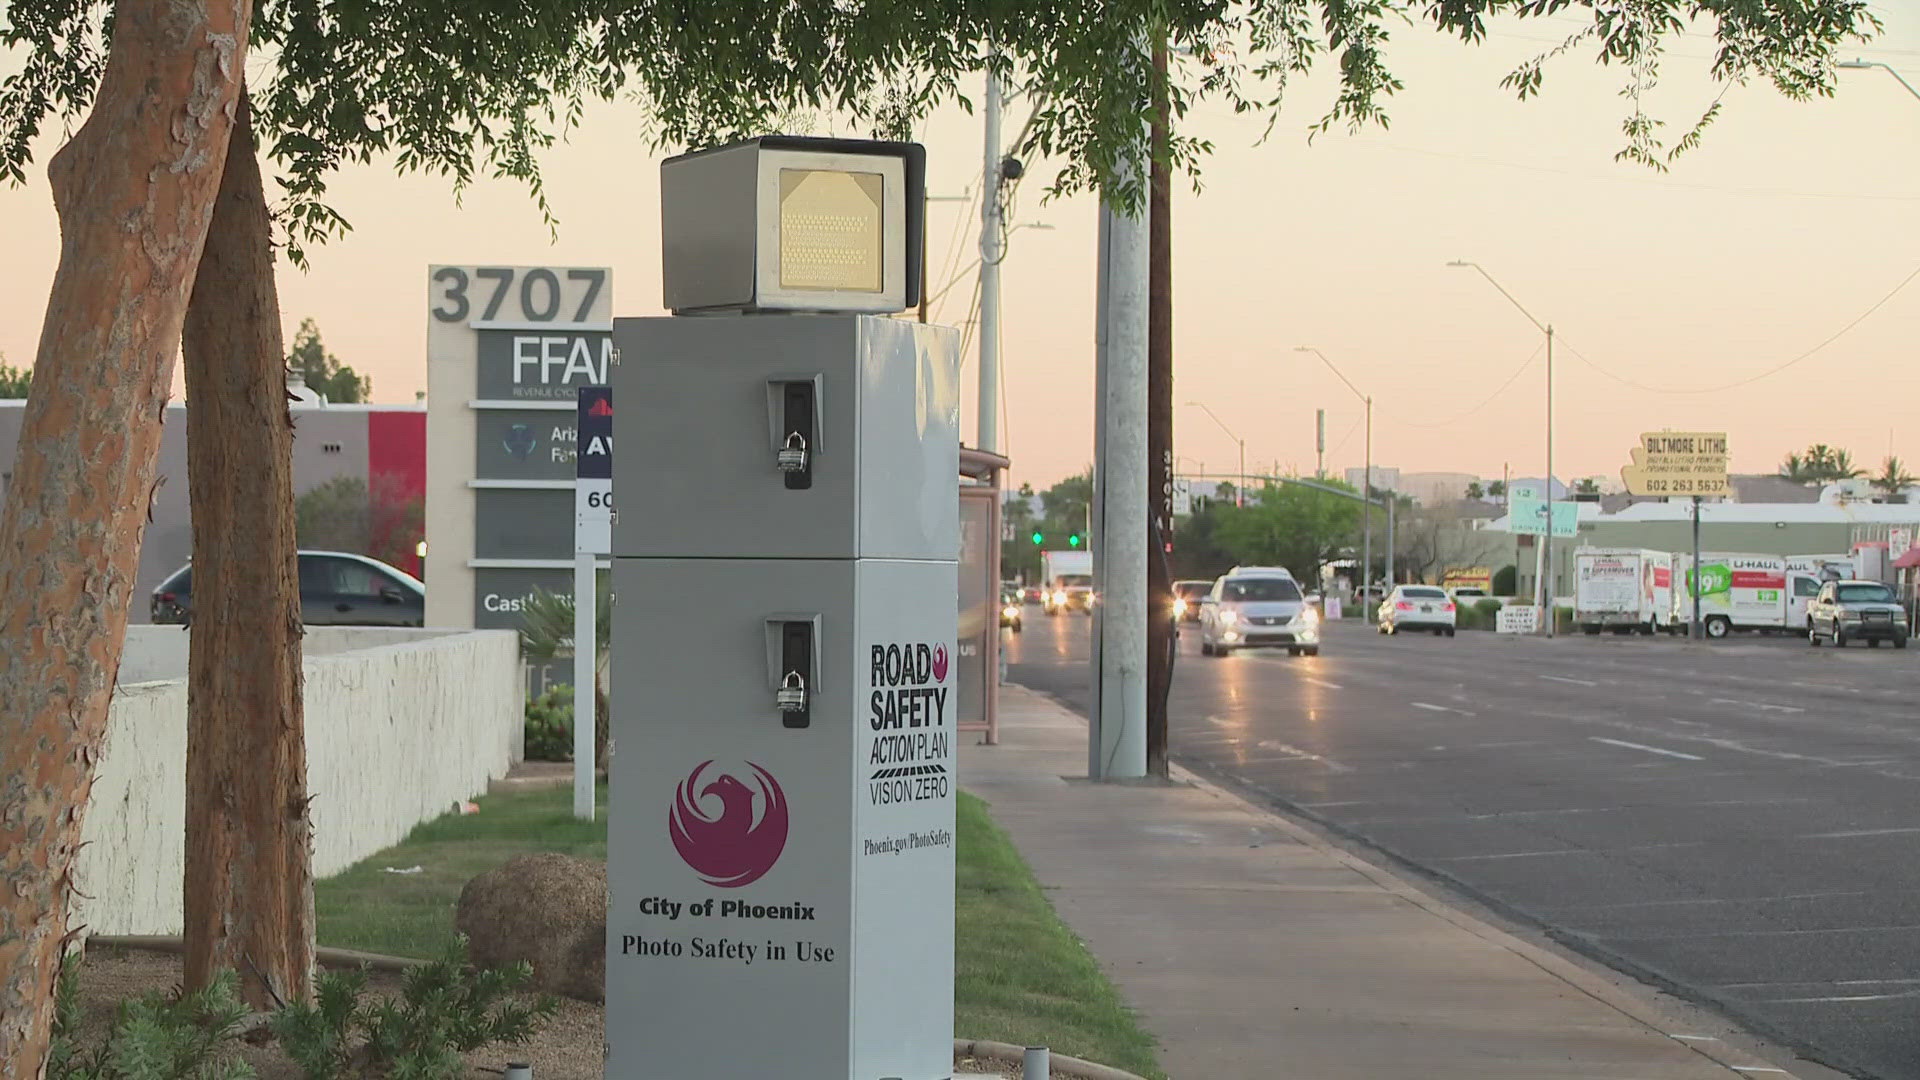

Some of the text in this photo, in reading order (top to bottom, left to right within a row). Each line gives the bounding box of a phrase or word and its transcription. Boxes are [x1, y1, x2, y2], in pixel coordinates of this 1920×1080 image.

[432, 267, 605, 323] 3707
[513, 387, 552, 397] REVENUE
[1647, 438, 1726, 454] BILTMORE LITHO
[1646, 479, 1725, 491] 602 263 5637
[1733, 560, 1779, 569] U-HAUL
[957, 644, 976, 657] US
[871, 643, 932, 687] ROAD
[870, 687, 948, 731] SAFETY
[870, 731, 948, 765] ACTION PLAN
[870, 775, 948, 806] VISION ZERO
[864, 829, 951, 856] Phoenix.gov/PhotoSafety
[639, 896, 815, 921] City of Phoenix
[622, 934, 835, 965] Photo Safety in Use
